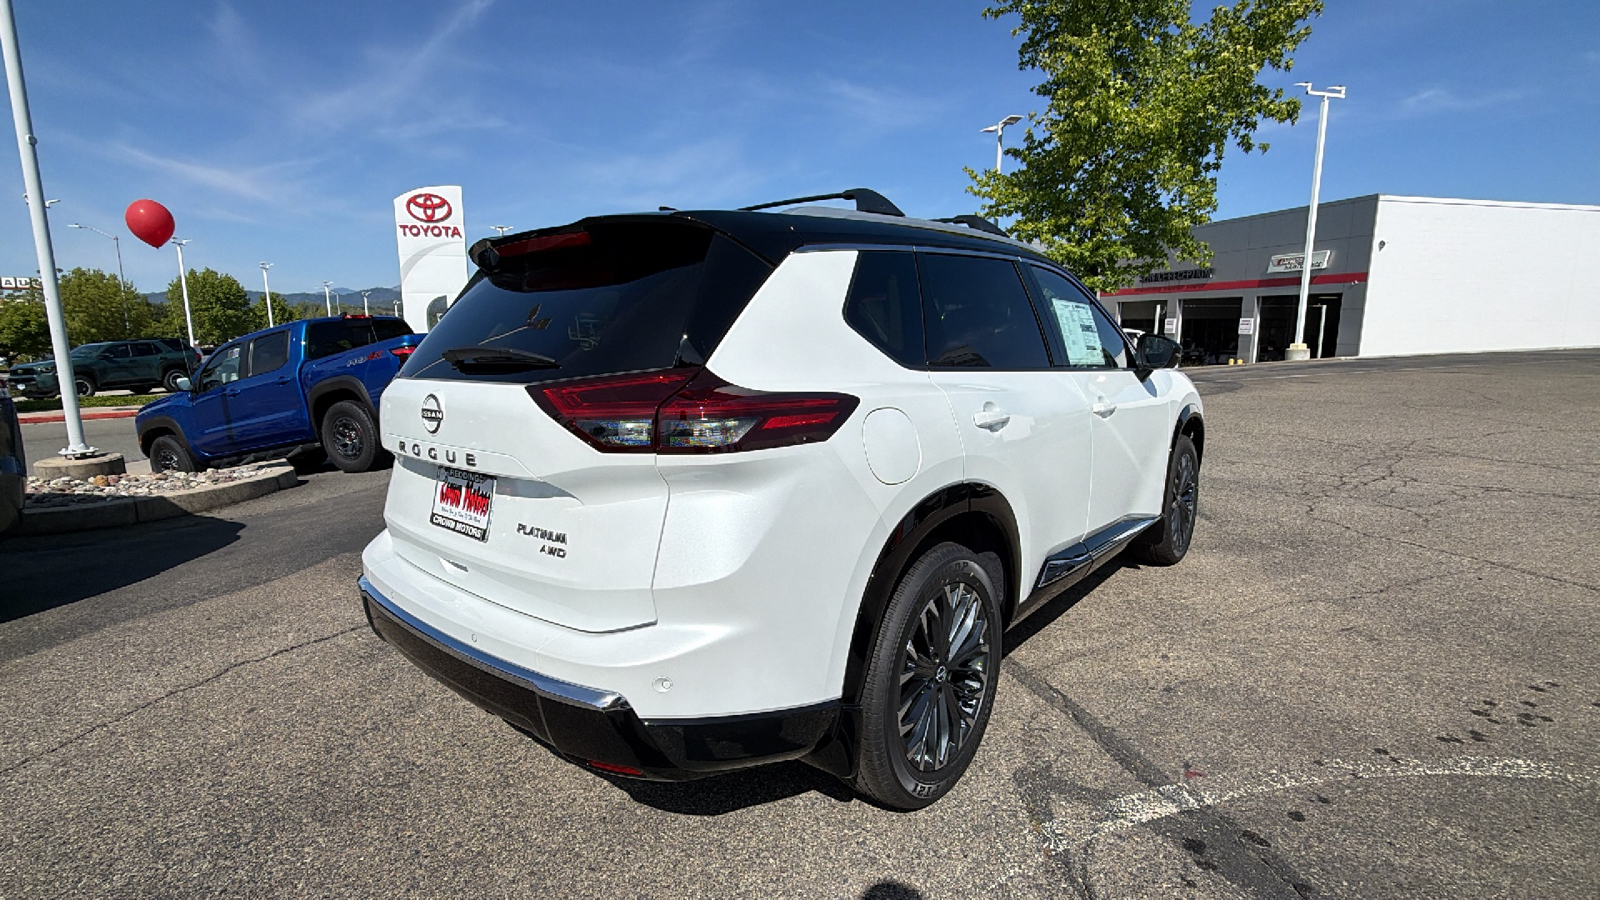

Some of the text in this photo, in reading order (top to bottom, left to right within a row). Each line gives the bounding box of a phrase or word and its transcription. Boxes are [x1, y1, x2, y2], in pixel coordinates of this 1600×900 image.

[399, 225, 462, 239] TOYOTA
[399, 440, 477, 467] ROGUE
[449, 469, 480, 483] REDDING
[433, 515, 455, 529] CROWN
[455, 521, 481, 538] MOTORS
[517, 523, 567, 545] PLATINUM
[540, 545, 567, 558] AWD
